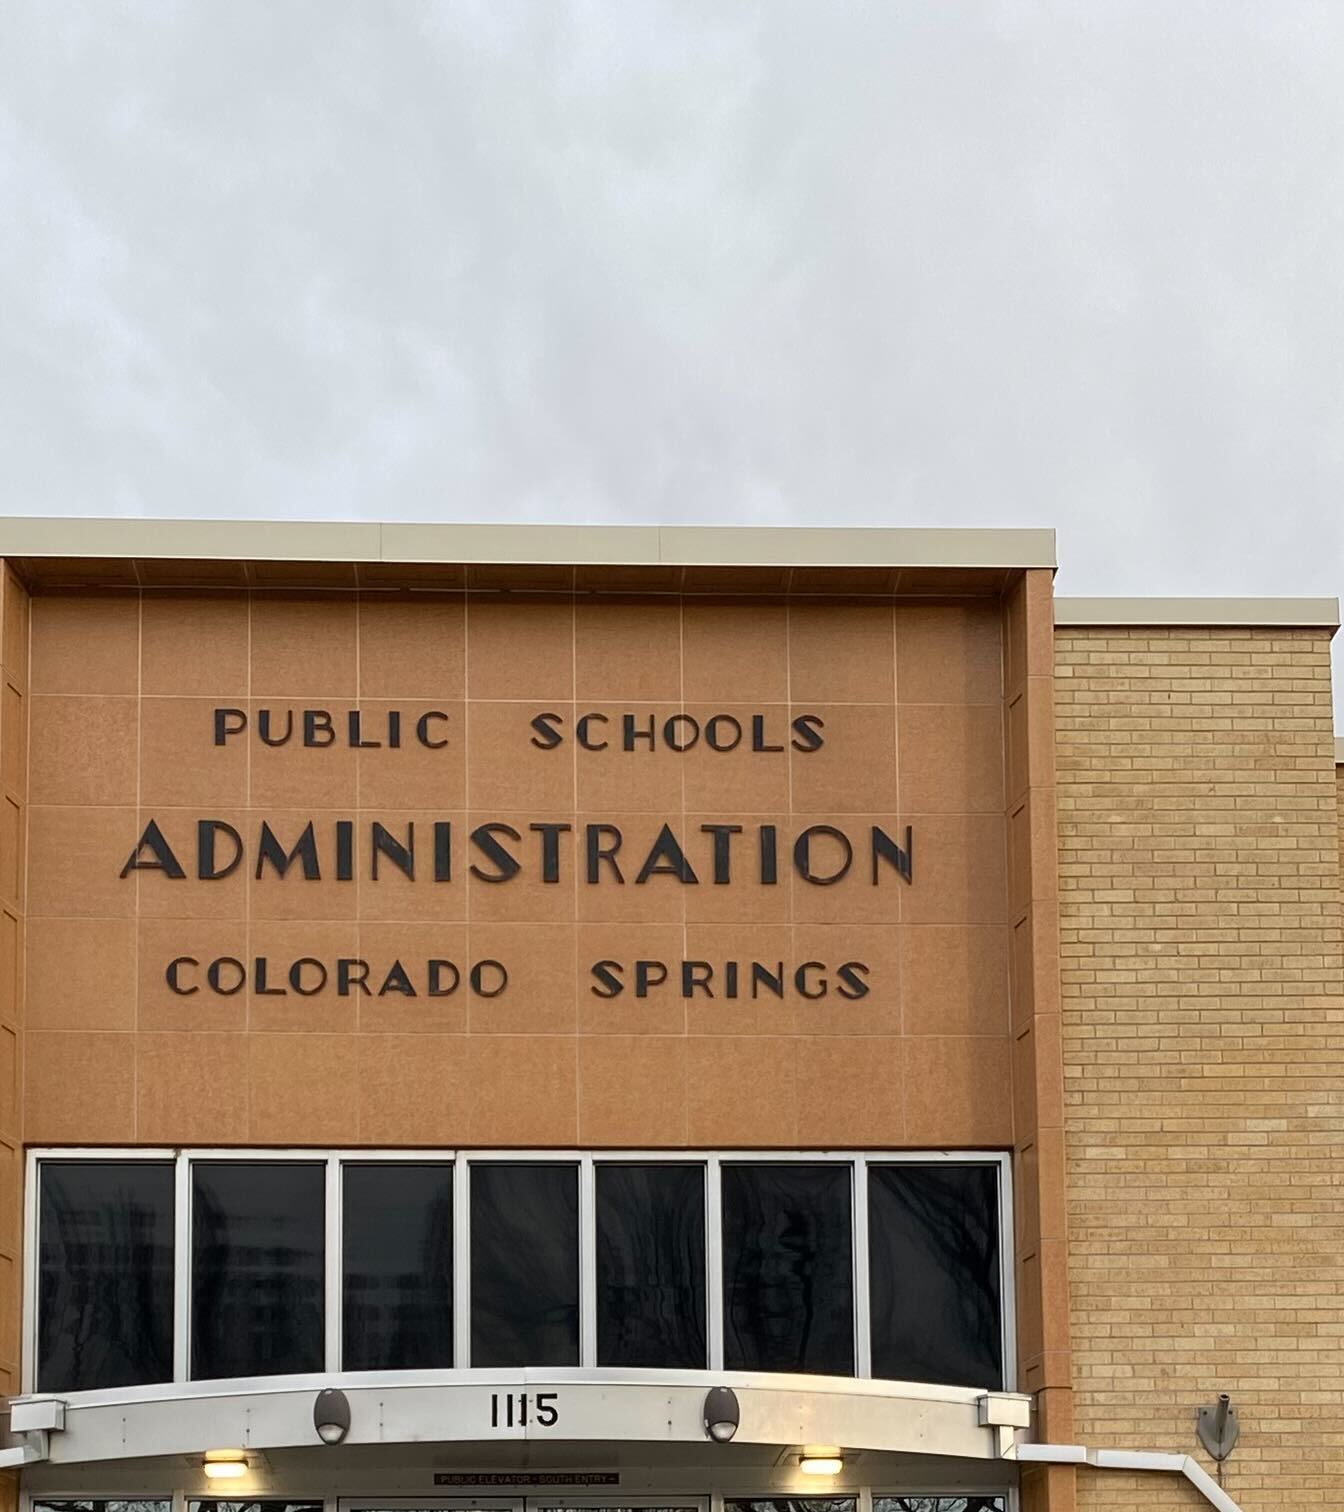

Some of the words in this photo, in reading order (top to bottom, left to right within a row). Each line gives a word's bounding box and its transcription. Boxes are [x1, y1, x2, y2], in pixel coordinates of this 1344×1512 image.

[213, 708, 450, 750] PUBLIC
[530, 712, 826, 752] SCHOOLS
[119, 818, 914, 886] ADMINISTRATION
[165, 956, 509, 998] COLORADO
[591, 960, 871, 1001] SPRINGS
[491, 1393, 558, 1427] 1115
[440, 1475, 476, 1484] PUBLIC
[479, 1475, 530, 1484] ELEVATOR
[539, 1475, 571, 1484] SOUTH
[575, 1474, 606, 1483] ENTRY
